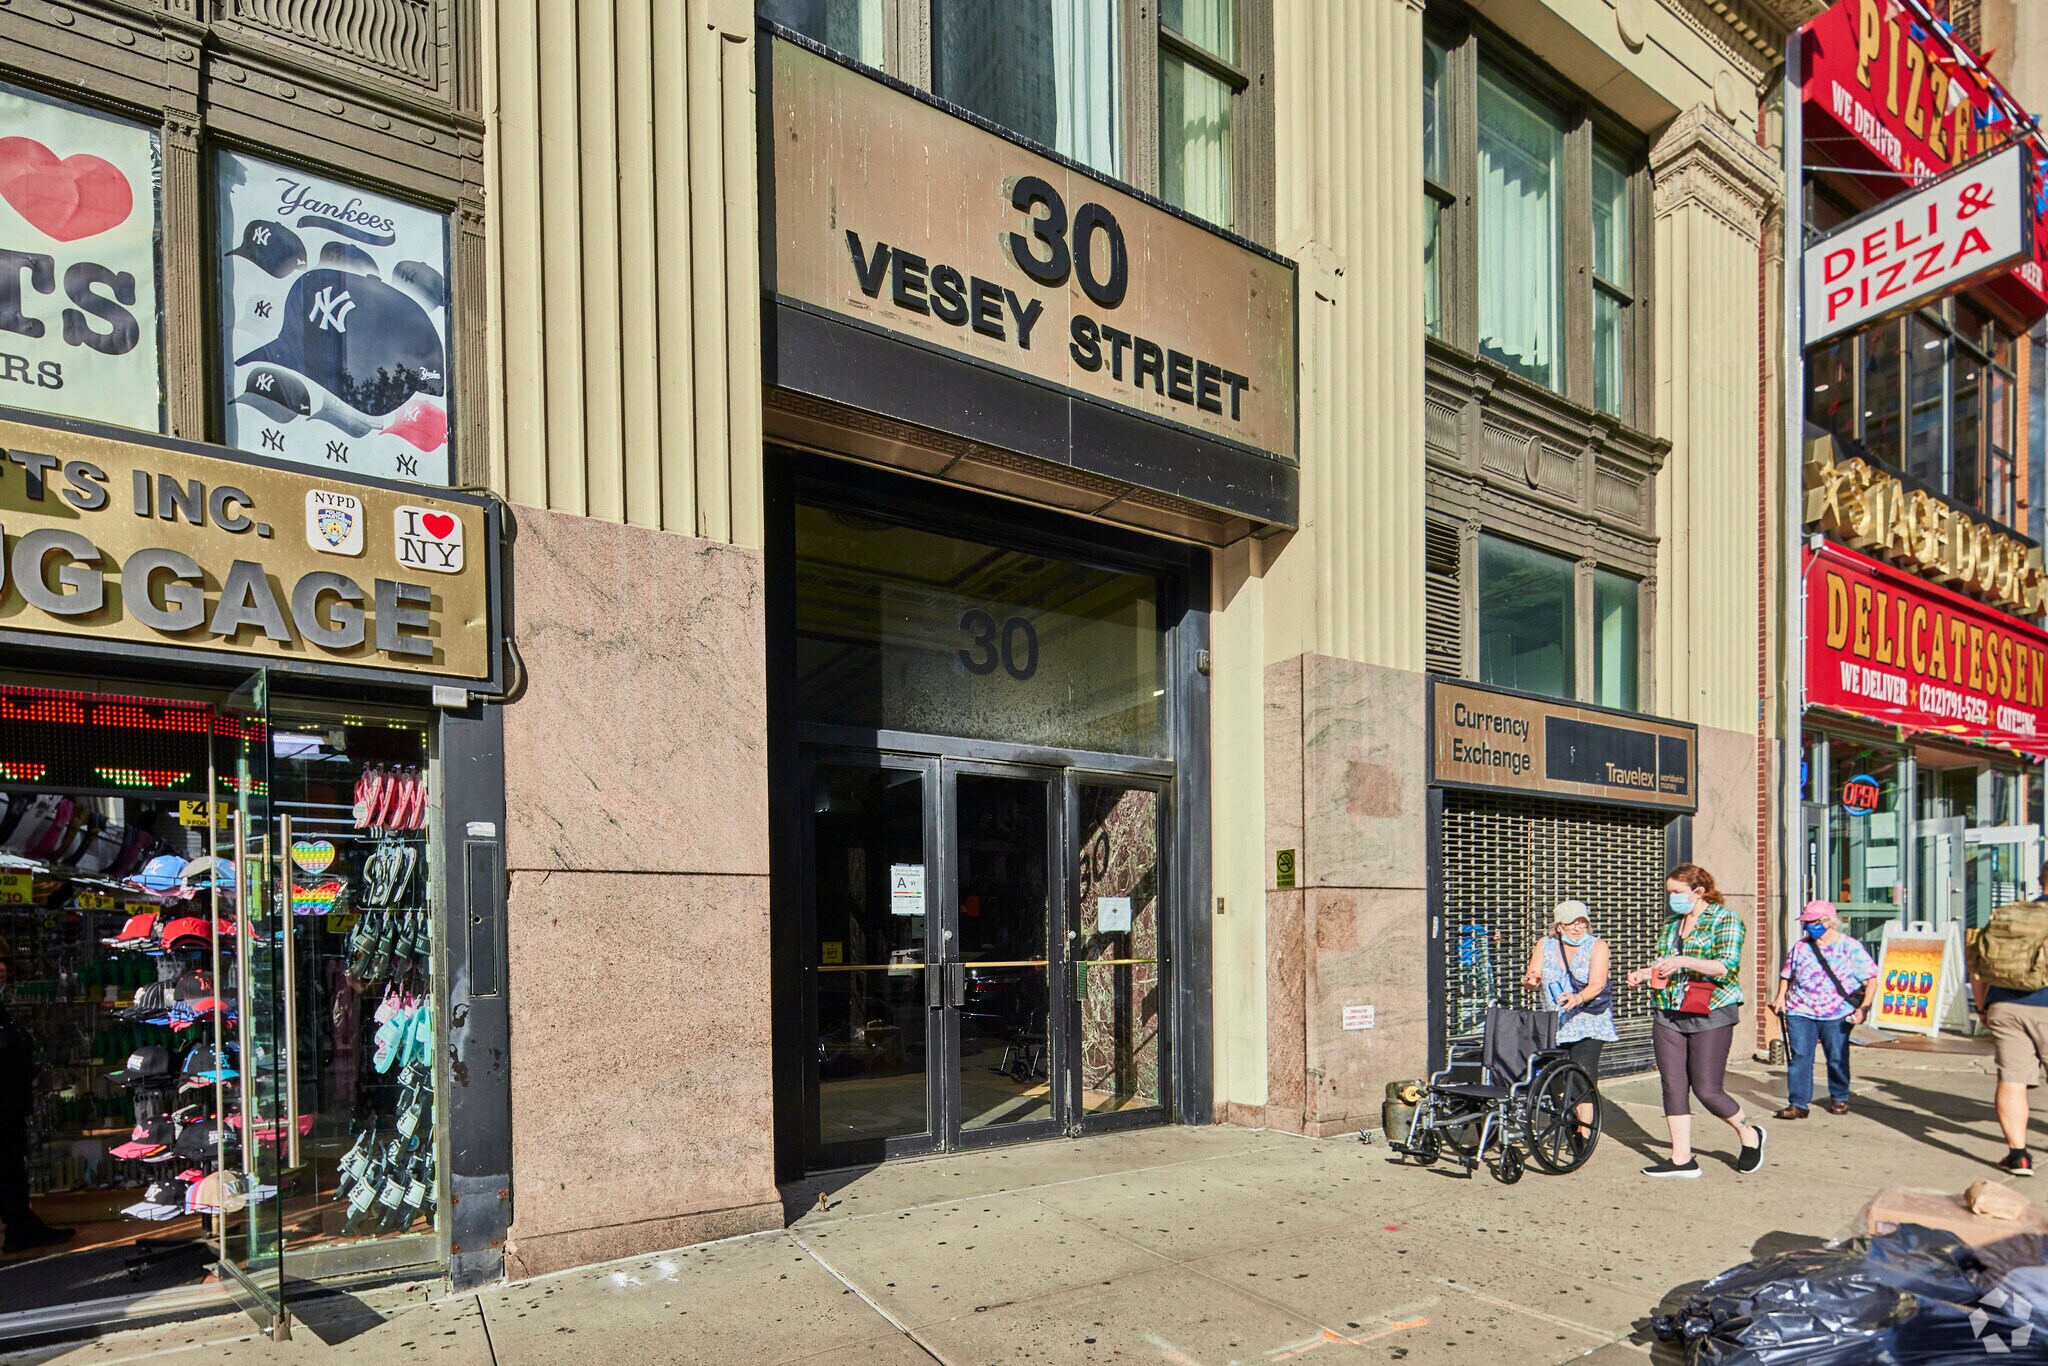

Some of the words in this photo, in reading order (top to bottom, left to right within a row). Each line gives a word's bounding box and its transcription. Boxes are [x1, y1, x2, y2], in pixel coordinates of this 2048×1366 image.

[1832, 80, 1853, 125] WE
[1854, 101, 1902, 170] DELIVER
[276, 178, 395, 240] Yankees
[252, 226, 271, 246] NY
[1009, 175, 1129, 310] 30
[1823, 202, 1938, 286] DELI
[1957, 183, 1995, 220] &
[1827, 226, 1992, 323] PIZZA
[309, 286, 356, 333] NY
[846, 229, 1043, 350] VESEY
[1069, 314, 1249, 421] STREET
[0, 353, 63, 390] RS
[261, 428, 285, 452] NY
[326, 440, 348, 464] NY
[397, 453, 418, 477] NY
[0, 448, 105, 510] TS
[133, 470, 271, 537] INC.
[315, 492, 355, 509] NYPD
[403, 510, 420, 537] I
[1838, 456, 1950, 575] STAGE
[1950, 509, 2031, 609] DOOR
[399, 537, 460, 567] NY
[0, 523, 434, 657] GGAGE
[959, 609, 1038, 681] 30
[1826, 571, 2045, 709] DELICATESSEN
[1840, 661, 1860, 693] WE
[1862, 667, 1908, 706] DELIVER
[1996, 705, 2037, 737] CATERING
[1454, 702, 1529, 742] Currency
[1453, 738, 1530, 775] Exchange
[1606, 762, 1654, 788] Travelex
[1843, 783, 1879, 809] OPEN
[897, 877, 907, 889] A
[1886, 970, 1933, 994] COLD
[1882, 992, 1928, 1019] BEER
